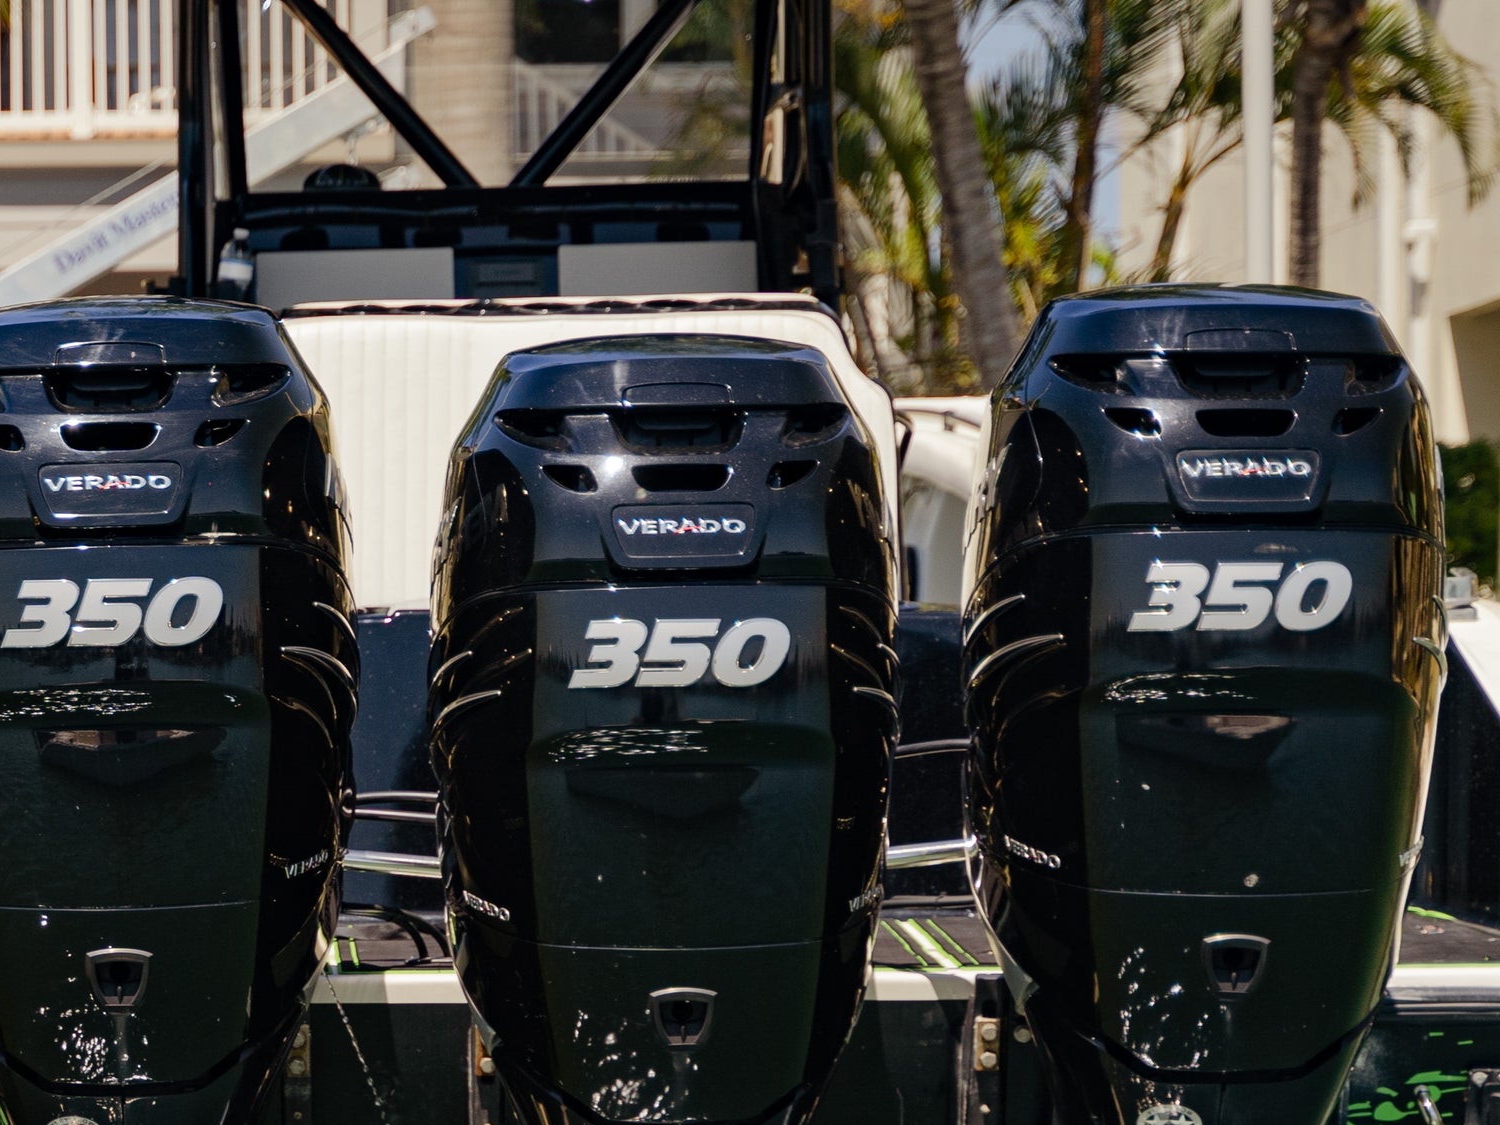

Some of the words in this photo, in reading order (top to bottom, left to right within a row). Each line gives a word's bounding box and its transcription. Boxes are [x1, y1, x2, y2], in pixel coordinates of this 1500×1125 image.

[44, 474, 172, 492] VERADO
[1181, 457, 1312, 478] VERADO
[617, 518, 746, 535] VERADO
[0, 576, 224, 648] 350
[1127, 559, 1353, 632] 350
[567, 616, 791, 689] 350
